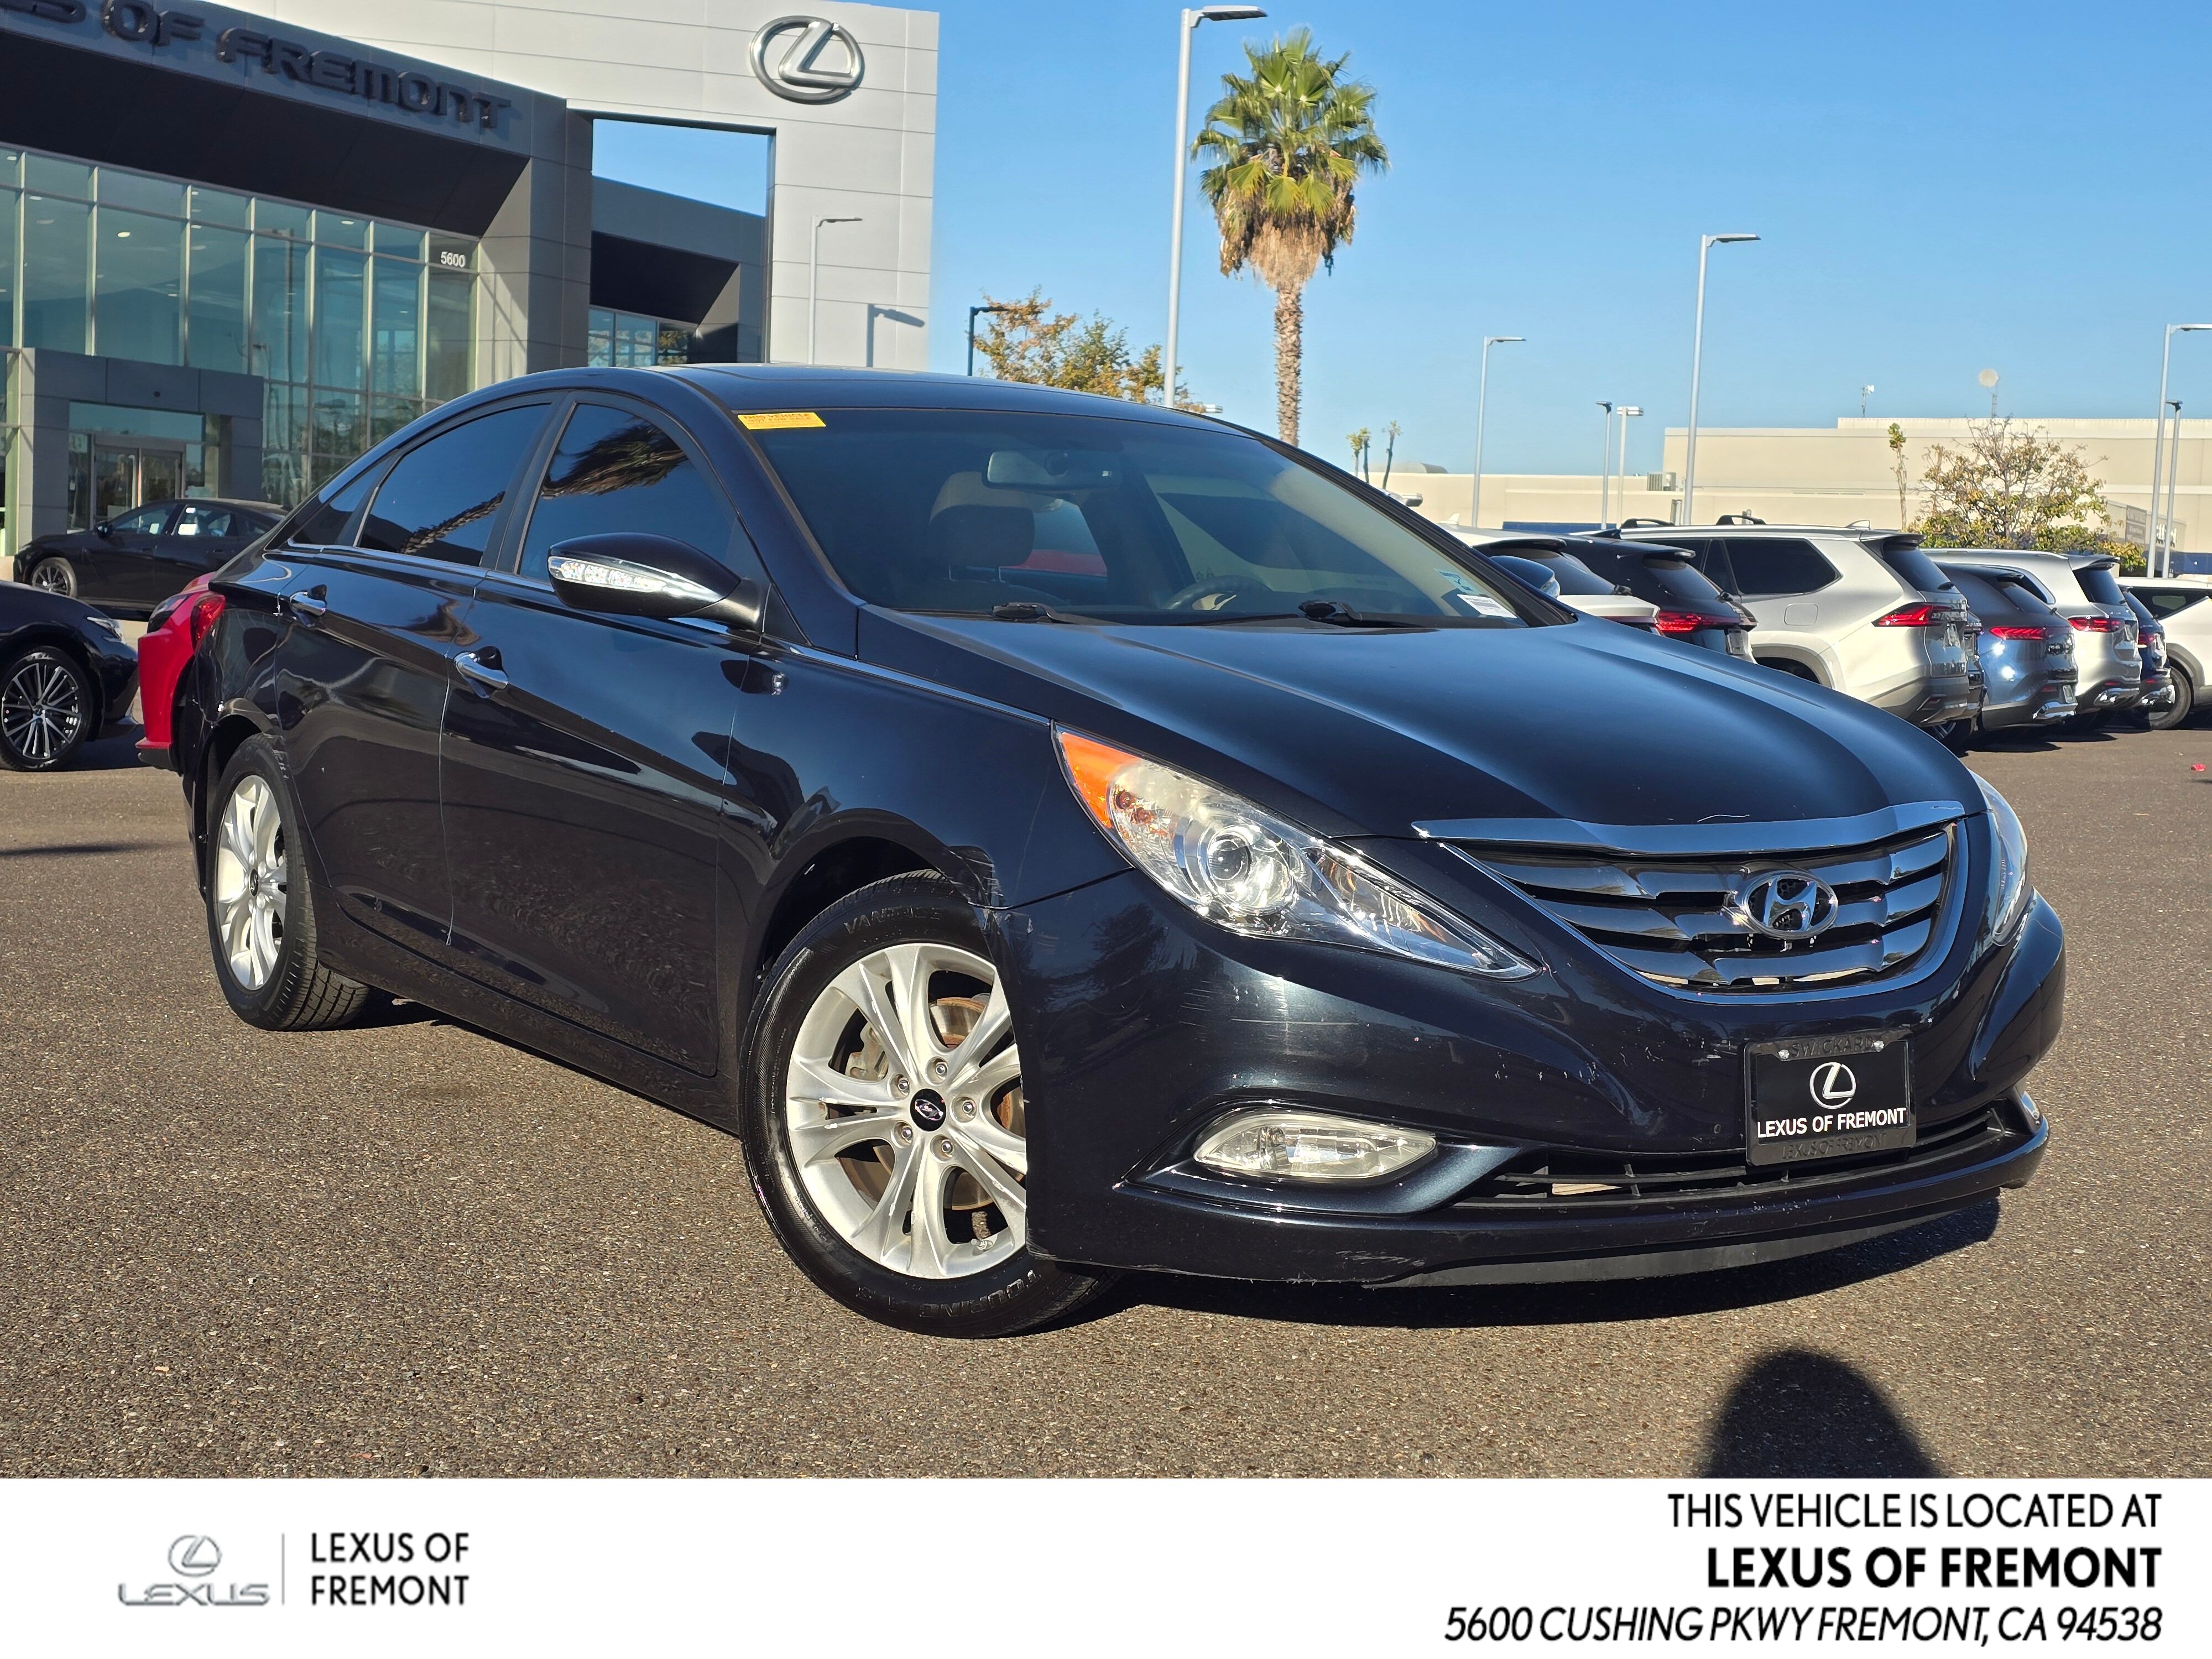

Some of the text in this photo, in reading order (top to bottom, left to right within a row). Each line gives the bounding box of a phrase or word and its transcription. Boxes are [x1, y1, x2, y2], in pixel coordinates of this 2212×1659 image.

[102, 0, 512, 128] OF FREMONT
[441, 251, 466, 268] 5600
[1791, 1035, 1875, 1057] SWICKARD
[1757, 1108, 1907, 1138] LEXUS OF FREMONT
[1782, 1133, 1888, 1160] LEXUS OF FREMONT
